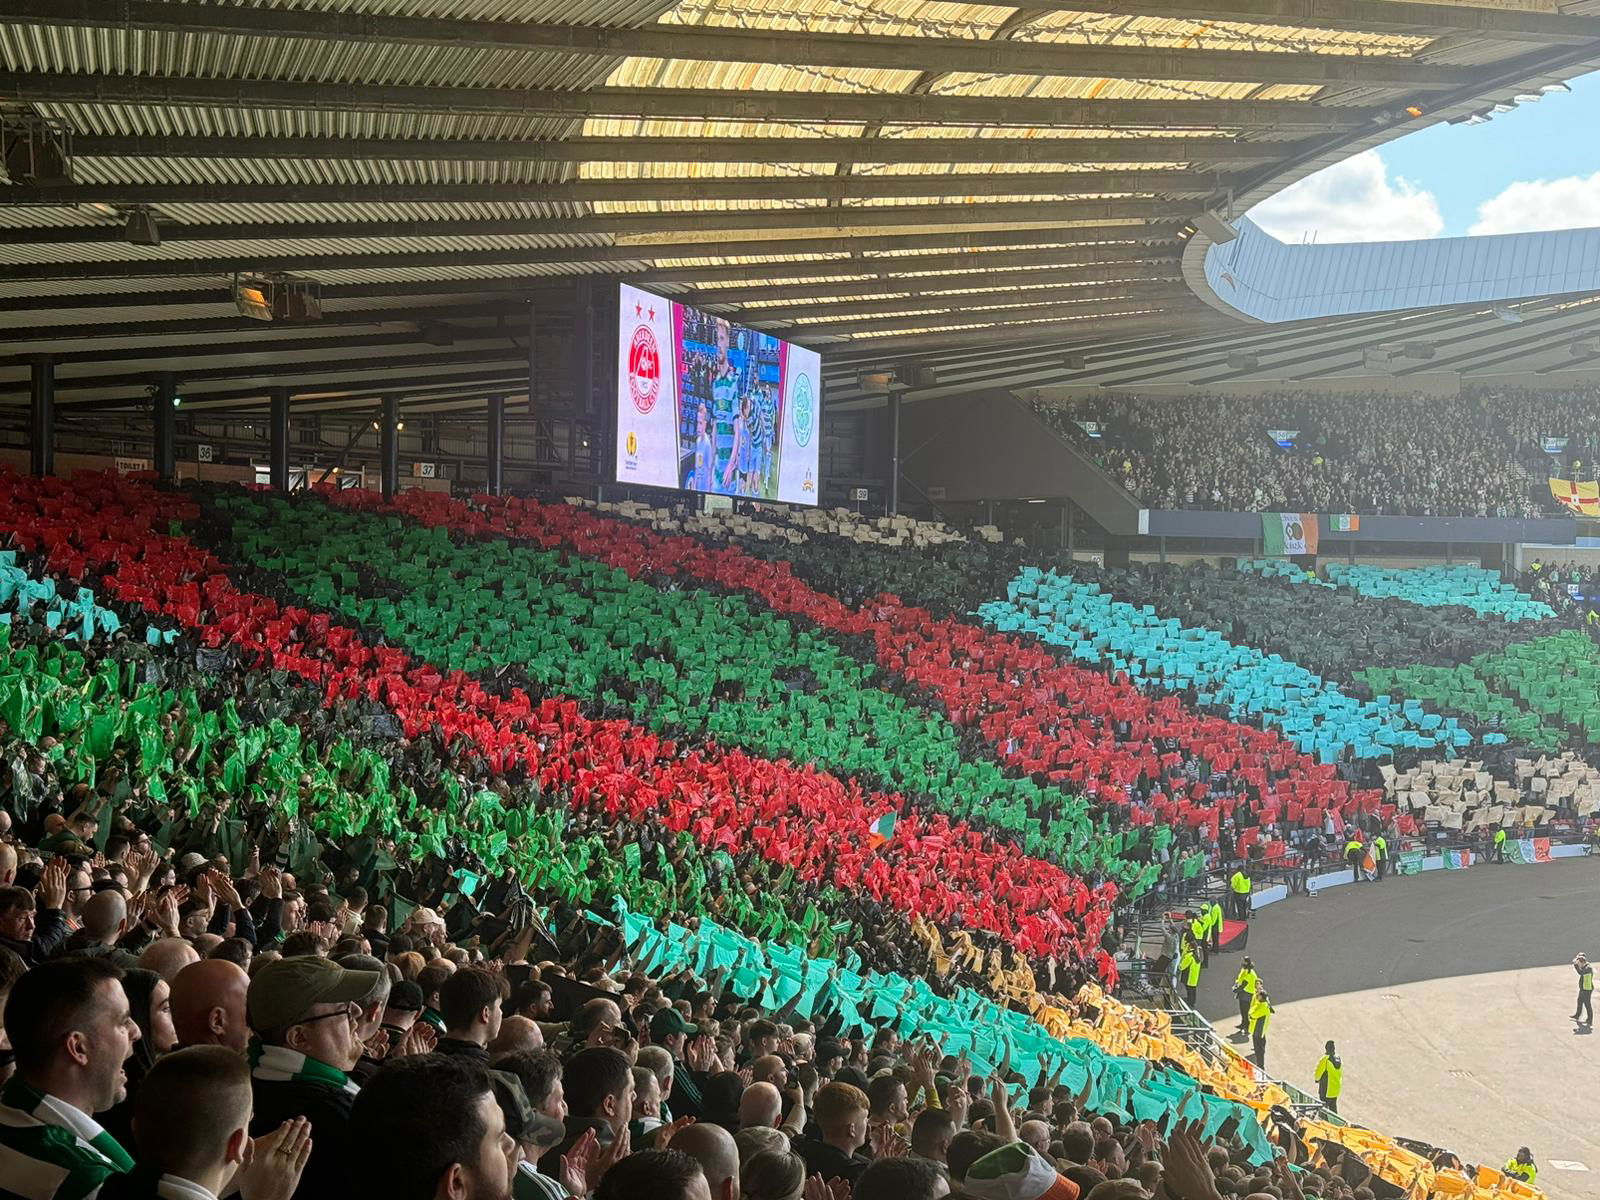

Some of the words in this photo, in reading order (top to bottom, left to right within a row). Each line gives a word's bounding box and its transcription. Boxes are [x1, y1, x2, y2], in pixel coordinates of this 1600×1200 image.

[200, 447, 210, 459] 36
[119, 462, 141, 470] TOILET
[422, 464, 433, 476] 37
[858, 490, 867, 499] 39
